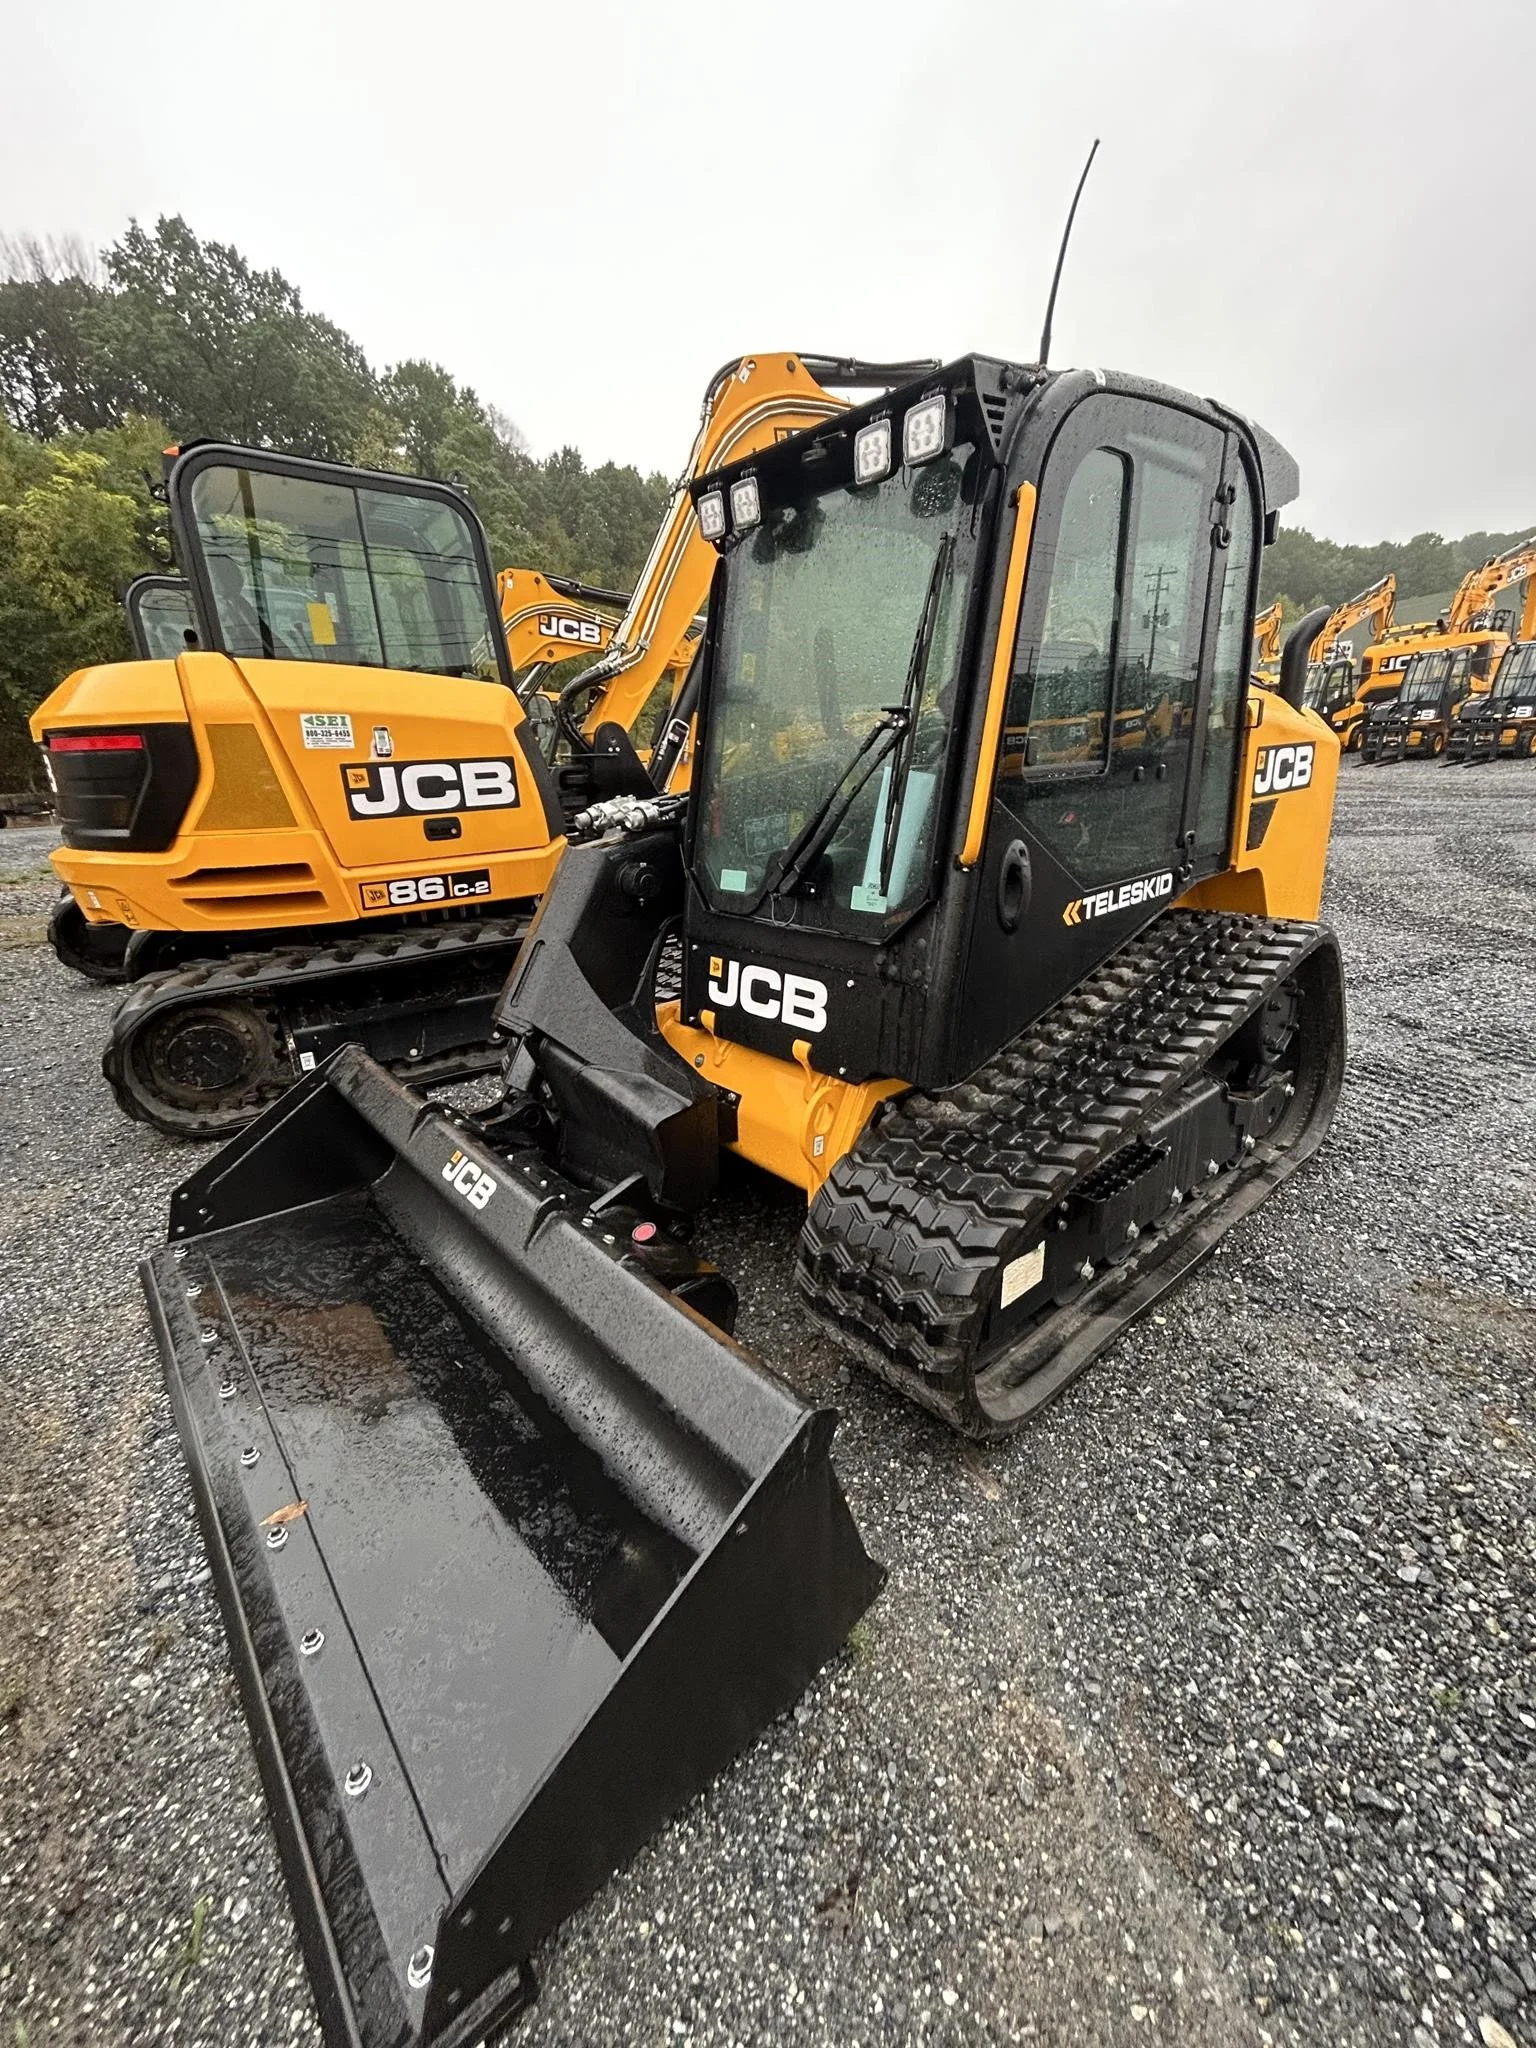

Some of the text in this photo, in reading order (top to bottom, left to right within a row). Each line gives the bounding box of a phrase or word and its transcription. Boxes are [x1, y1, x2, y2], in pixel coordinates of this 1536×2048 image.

[540, 616, 601, 643] JCB
[1380, 655, 1412, 672] JC
[314, 715, 348, 727] SEI
[351, 761, 516, 815] JCB
[1254, 745, 1314, 794] JCB
[388, 877, 446, 905] 86
[453, 880, 490, 897] C-2
[1082, 873, 1173, 920] TELESKID
[708, 960, 828, 1033] JCB
[442, 1155, 498, 1210] JCB
